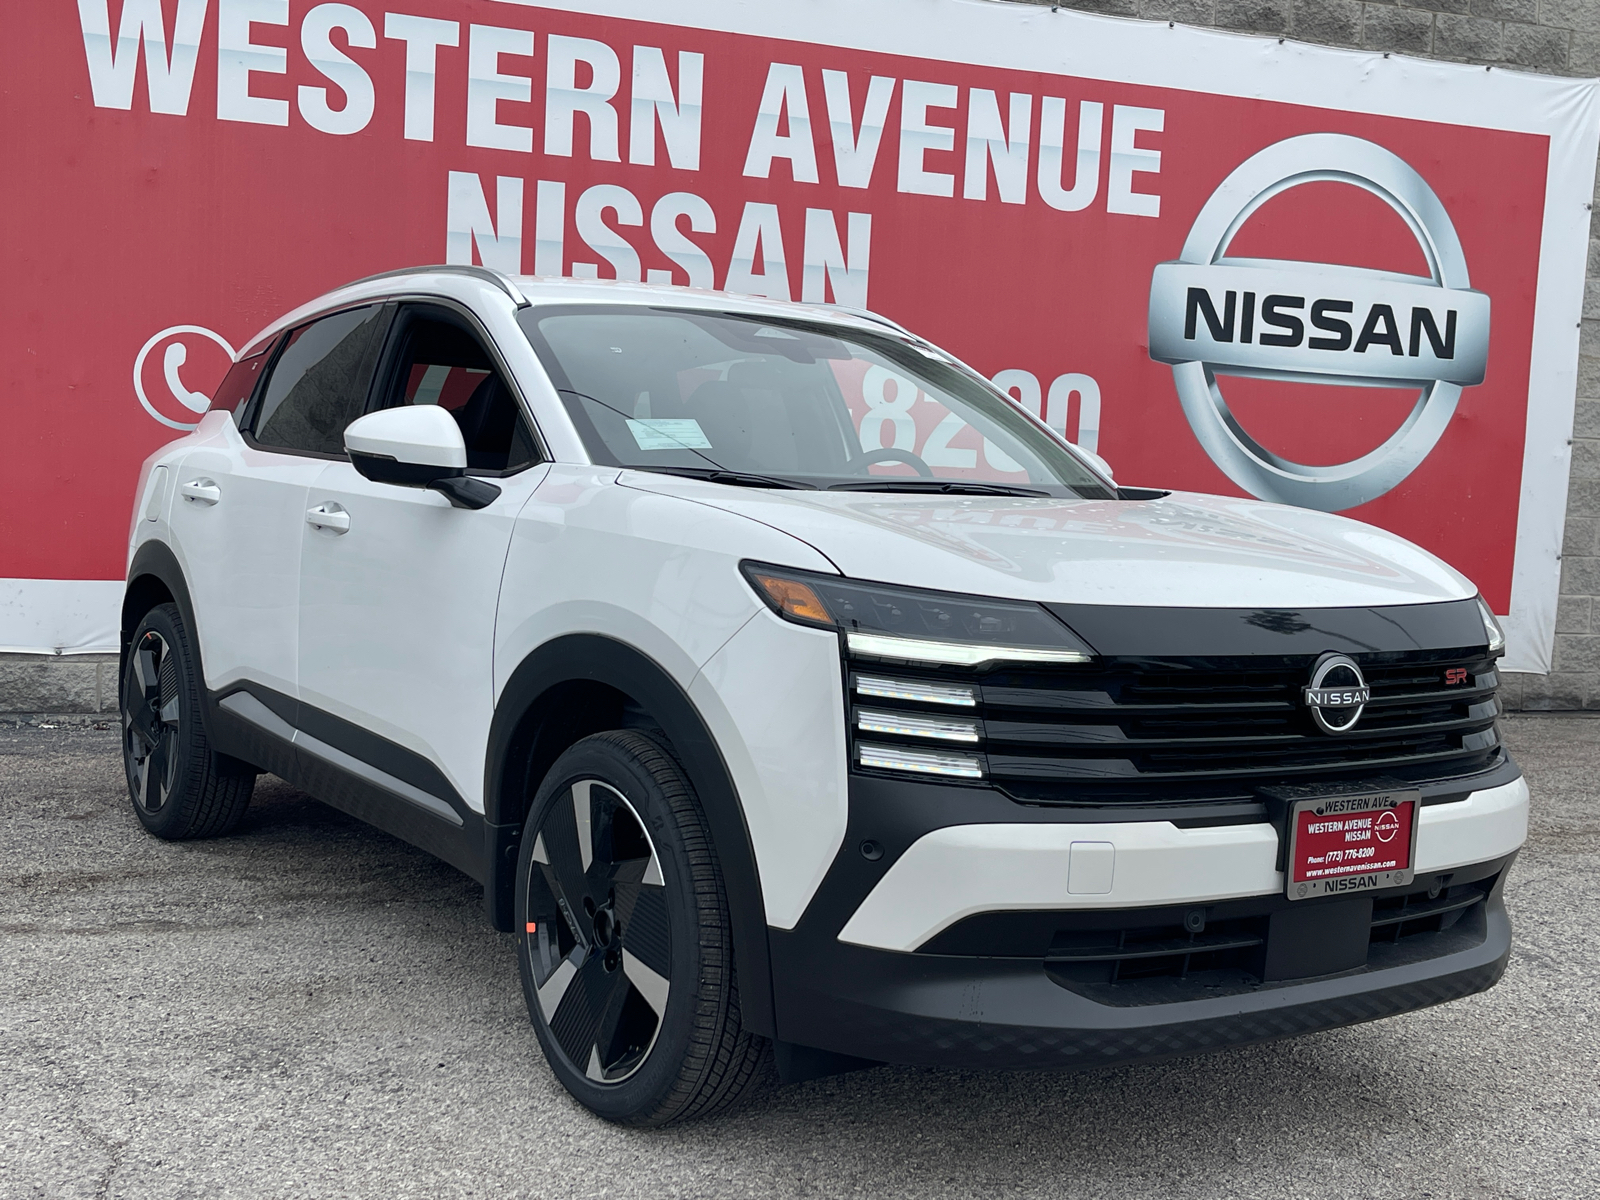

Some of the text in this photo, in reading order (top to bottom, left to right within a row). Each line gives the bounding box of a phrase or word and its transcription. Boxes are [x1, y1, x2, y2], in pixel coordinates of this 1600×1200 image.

[77, 0, 1165, 219] WESTERN AVENUE
[446, 171, 872, 305] NISSAN
[1183, 287, 1457, 360] NISSAN
[1445, 668, 1467, 684] SR
[1308, 689, 1370, 705] NISSAN
[1324, 796, 1390, 813] WESTERN AVE
[1308, 818, 1372, 834] WESTERN AVENUE
[1374, 823, 1399, 831] NISSAN
[1345, 830, 1371, 842] NISSAN
[1307, 846, 1375, 864] Phone: (773) 776-8200
[1306, 860, 1396, 877] www.westernavenissan.com
[1324, 875, 1377, 893] NISSAN
